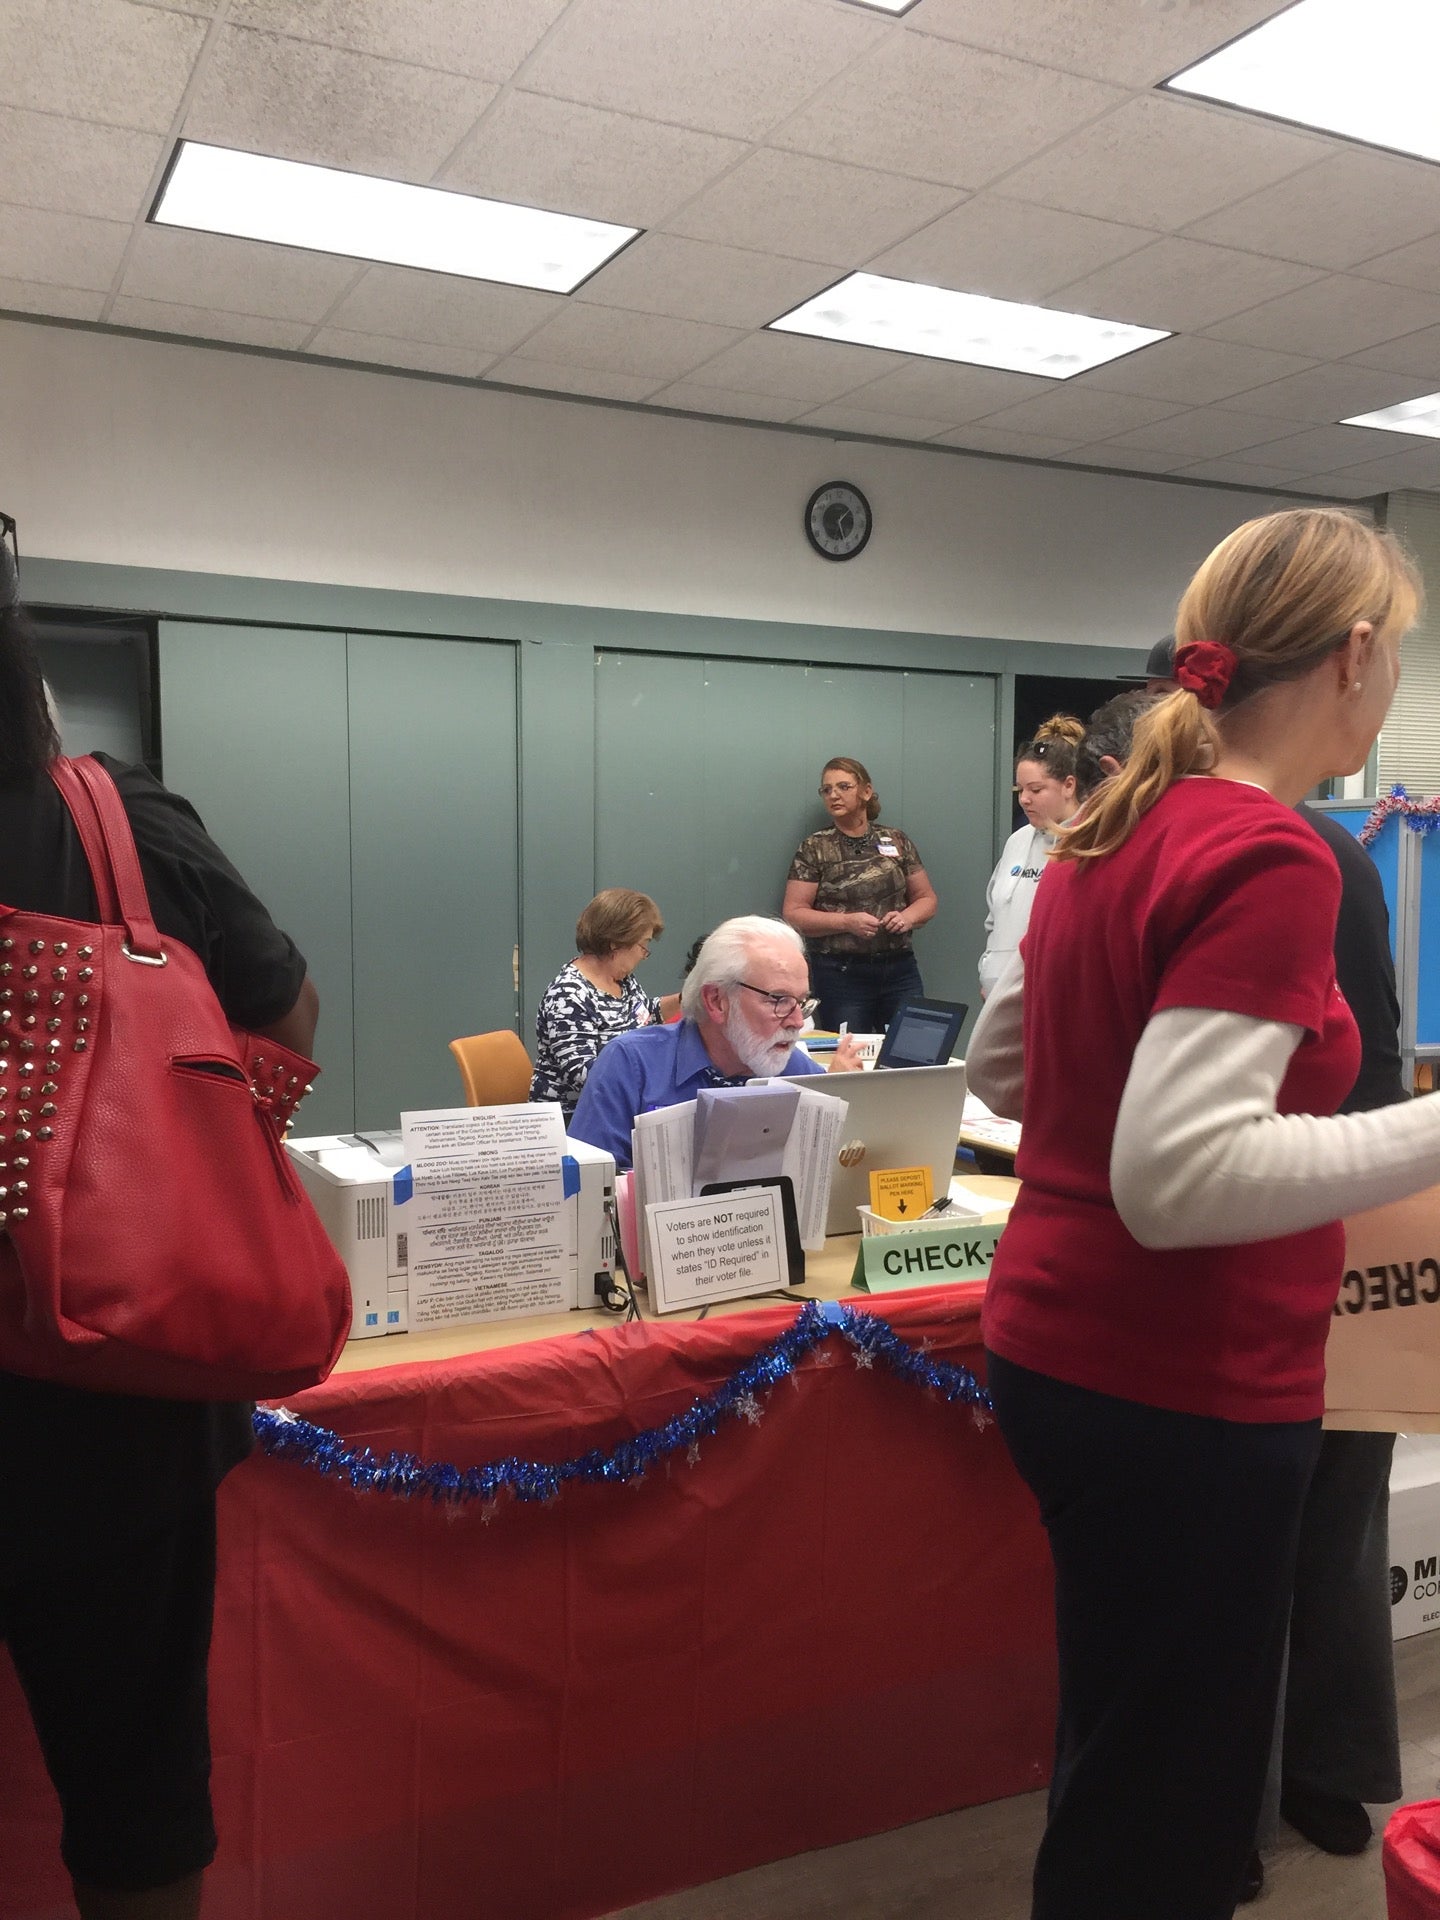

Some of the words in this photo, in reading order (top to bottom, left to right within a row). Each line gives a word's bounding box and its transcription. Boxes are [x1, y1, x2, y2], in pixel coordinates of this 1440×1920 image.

[666, 1221, 695, 1232] Voters
[698, 1218, 711, 1227] are
[714, 1213, 733, 1224] NOT
[736, 1207, 769, 1220] required
[677, 1237, 685, 1245] to
[688, 1234, 709, 1243] show
[712, 1224, 763, 1239] identification
[671, 1250, 695, 1260] when
[697, 1247, 715, 1256] they
[717, 1242, 735, 1253] vote
[738, 1238, 764, 1249] unless
[766, 1236, 771, 1244] it
[676, 1264, 702, 1275] states
[474, 1282, 507, 1291] VIETNAMESE
[696, 1275, 714, 1286] their
[716, 1272, 736, 1281] voter
